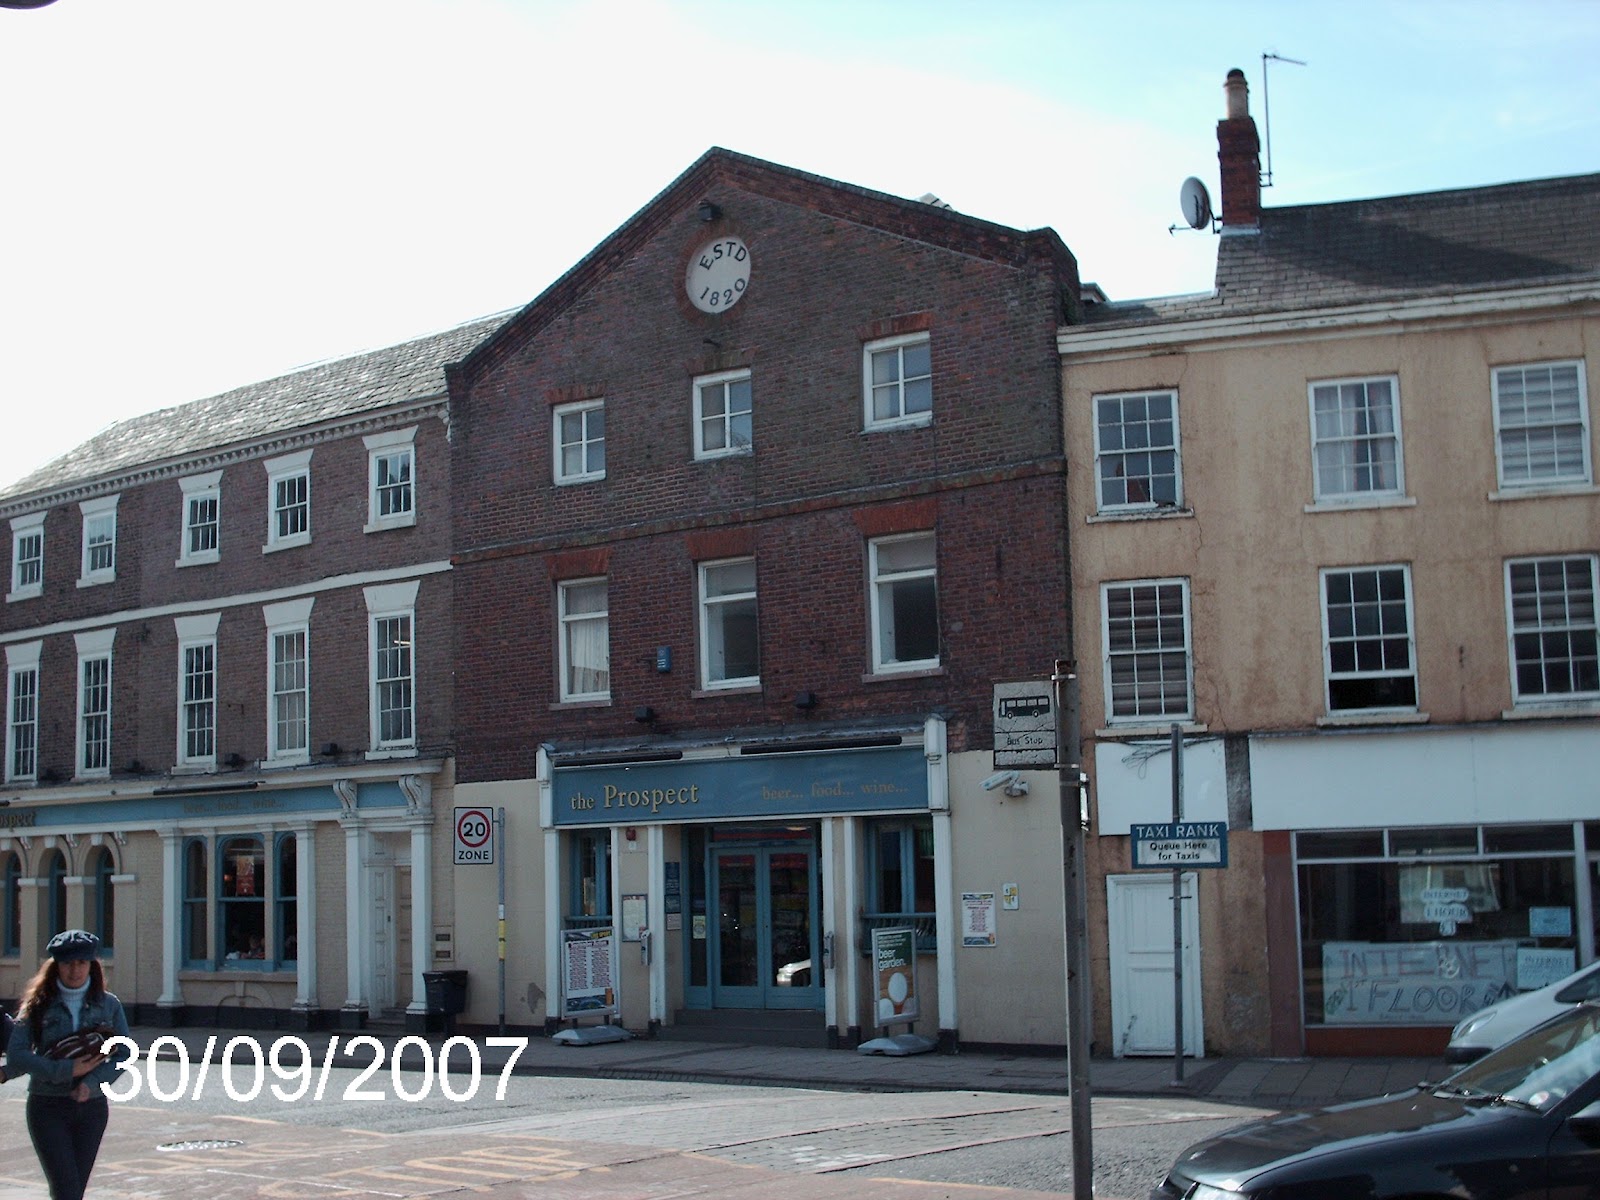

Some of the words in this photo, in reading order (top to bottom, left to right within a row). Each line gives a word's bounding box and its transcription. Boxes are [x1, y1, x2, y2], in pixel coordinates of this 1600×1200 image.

[699, 241, 747, 270] ESTD
[700, 278, 746, 306] 1820
[1007, 736, 1020, 745] Bus
[1024, 736, 1044, 745] Stop
[571, 792, 595, 810] the
[603, 784, 700, 814] Prospect
[463, 822, 486, 837] 20
[1136, 826, 1169, 839] TAXI
[1176, 824, 1220, 837] RANK
[1149, 842, 1180, 851] Queue
[1184, 841, 1208, 850] Here
[458, 850, 489, 860] ZONE
[1158, 852, 1172, 861] for
[1176, 851, 1200, 860] Taxis
[878, 949, 896, 959] beer
[1338, 944, 1513, 979] INTERNET
